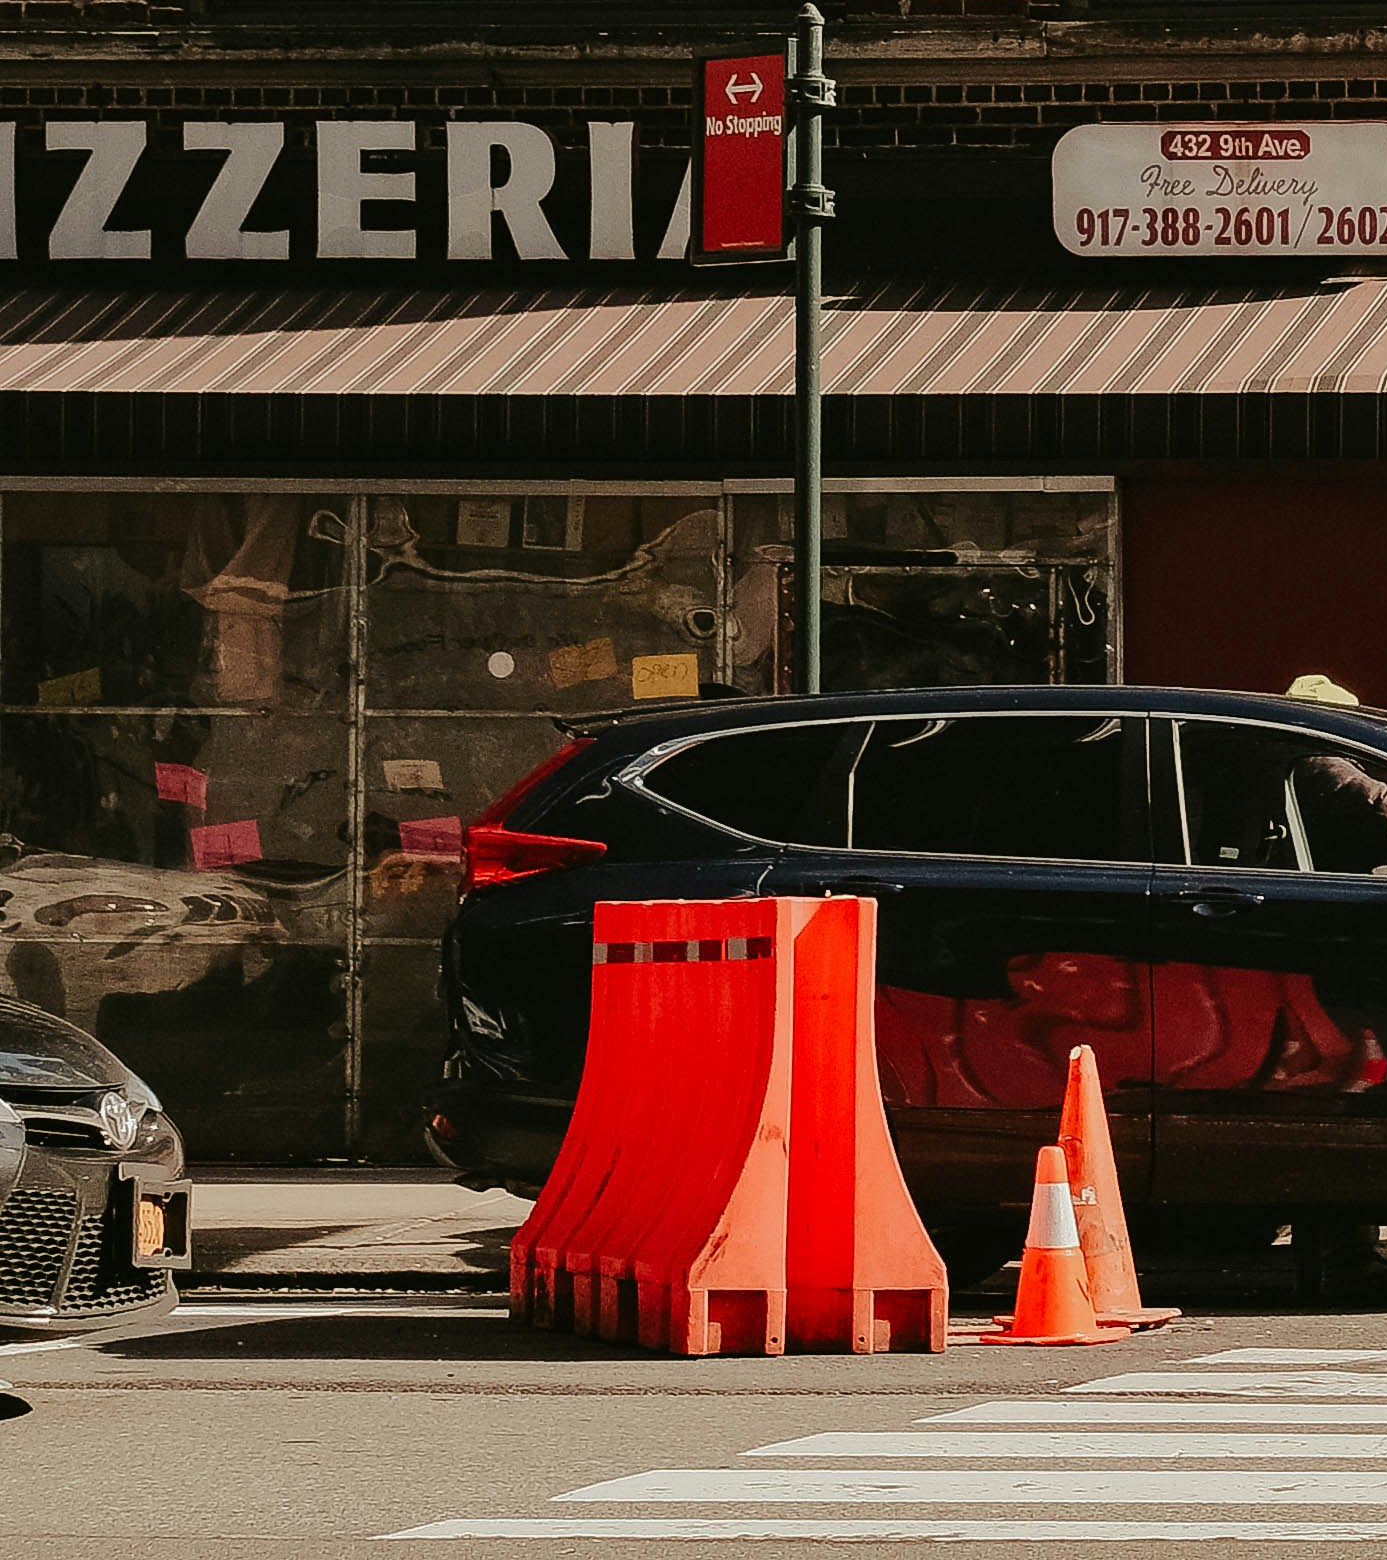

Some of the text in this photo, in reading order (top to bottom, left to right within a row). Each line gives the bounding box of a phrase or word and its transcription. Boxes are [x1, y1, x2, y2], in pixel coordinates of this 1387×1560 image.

[706, 111, 782, 138] No Stopping
[1168, 135, 1305, 157] 432 9th Ave.
[1140, 164, 1319, 208] Free Delivery
